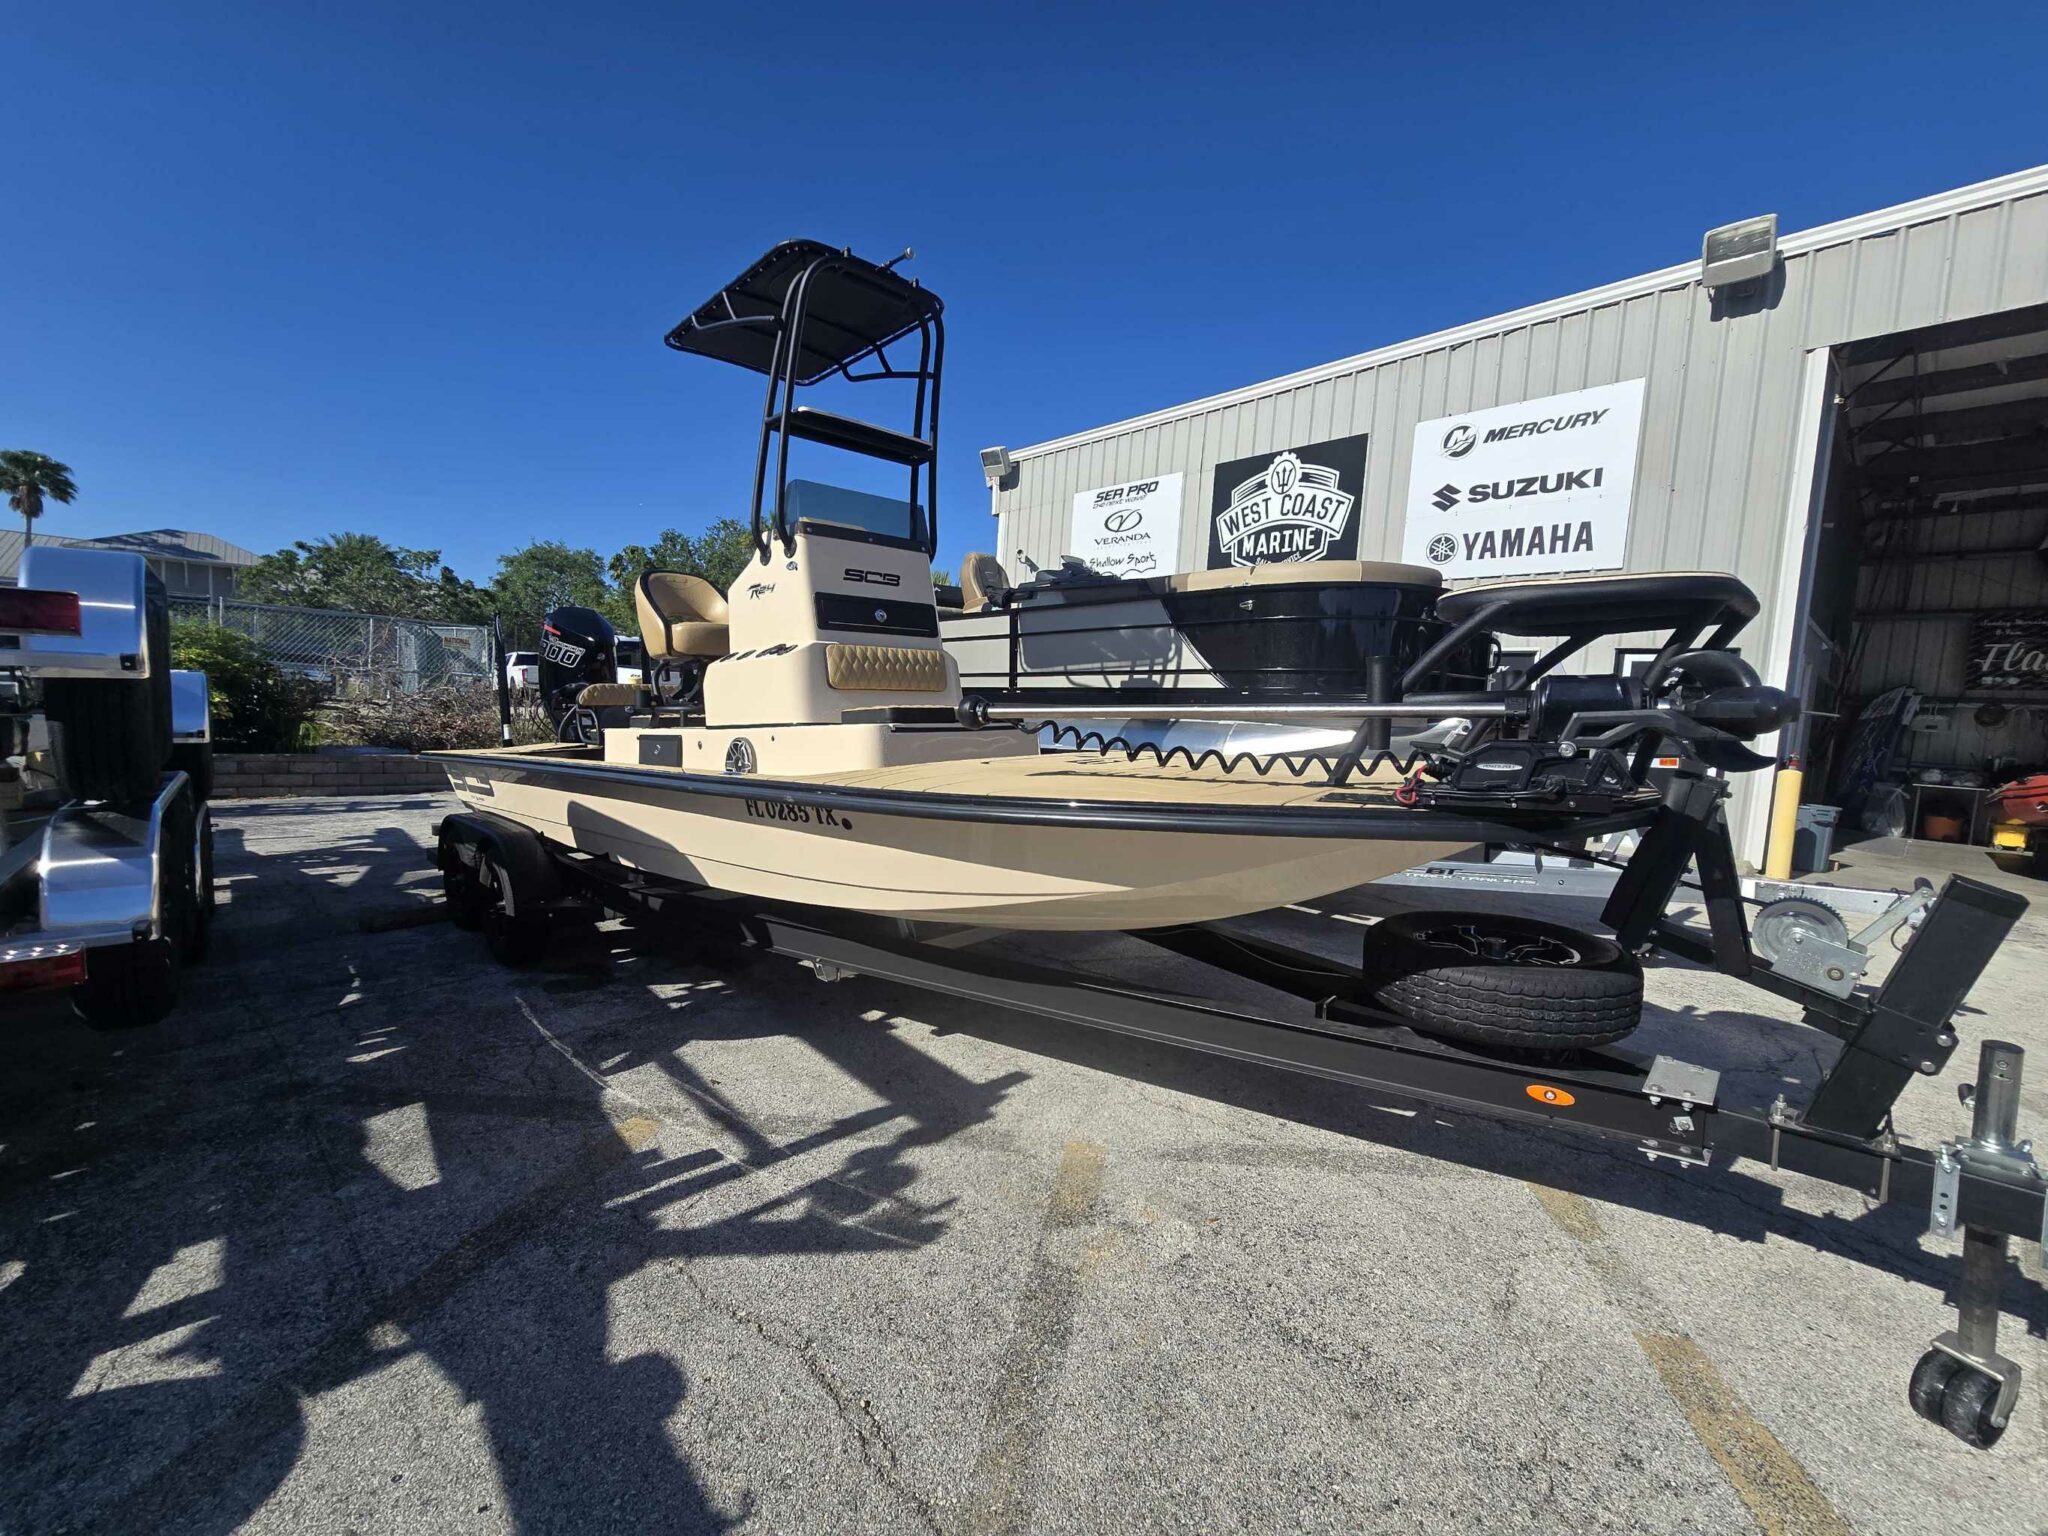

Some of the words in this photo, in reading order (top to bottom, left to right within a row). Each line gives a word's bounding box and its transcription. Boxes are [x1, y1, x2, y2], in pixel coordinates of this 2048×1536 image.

[1482, 408, 1610, 443] MERCURY
[1094, 487, 1124, 503] SEA
[1126, 481, 1159, 497] PRO
[1467, 467, 1604, 503] SUZUKI
[1223, 497, 1272, 536] WEST
[1280, 493, 1345, 524] COAST
[1094, 532, 1151, 546] VERANDA
[1242, 527, 1318, 557] MARINE
[1462, 520, 1594, 561] YAMAHA
[1089, 556, 1124, 568] Shallow
[1127, 552, 1155, 567] Sport
[843, 568, 900, 587] SCB
[1973, 641, 2048, 672] Fla
[745, 799, 764, 818] FL
[765, 800, 810, 823] 0285
[812, 805, 839, 826] TX
